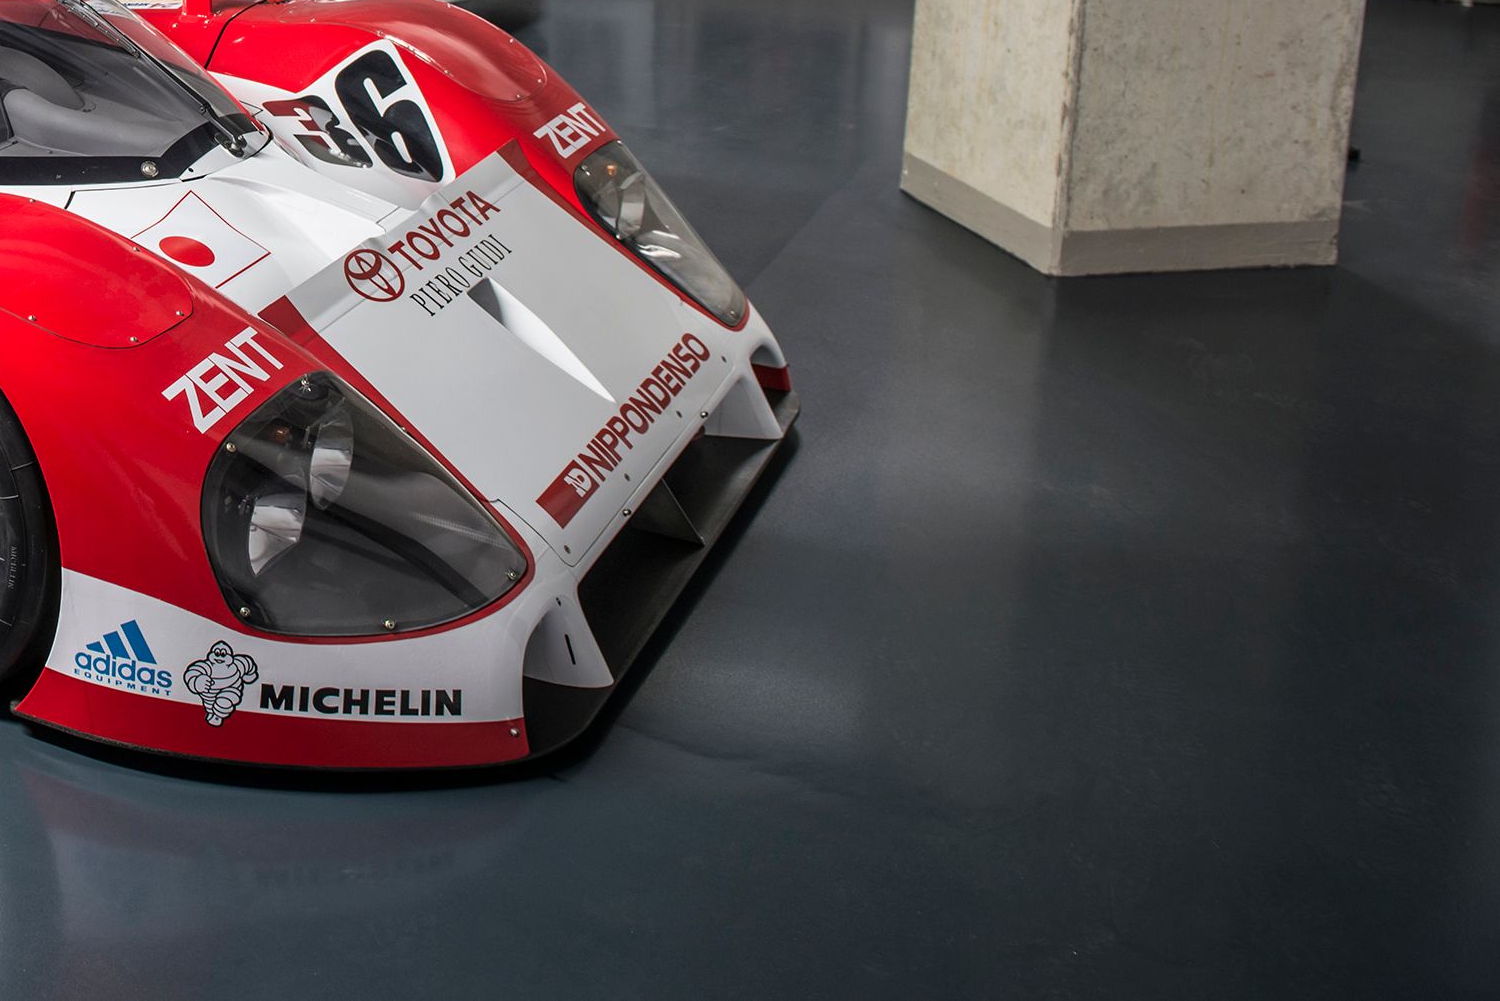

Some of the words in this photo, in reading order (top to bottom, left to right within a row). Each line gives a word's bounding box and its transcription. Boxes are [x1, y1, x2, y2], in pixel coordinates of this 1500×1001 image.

[262, 49, 444, 183] 36
[532, 102, 606, 159] ZENT
[388, 190, 501, 271] TOYOTA
[409, 266, 471, 317] PIERO
[458, 233, 513, 278] GUIDI
[161, 327, 284, 435] ZENT
[580, 332, 711, 483] NIPPONDENSO
[73, 667, 173, 697] EQUIPMENT
[74, 650, 173, 689] adidas
[259, 683, 463, 717] MICHELIN
